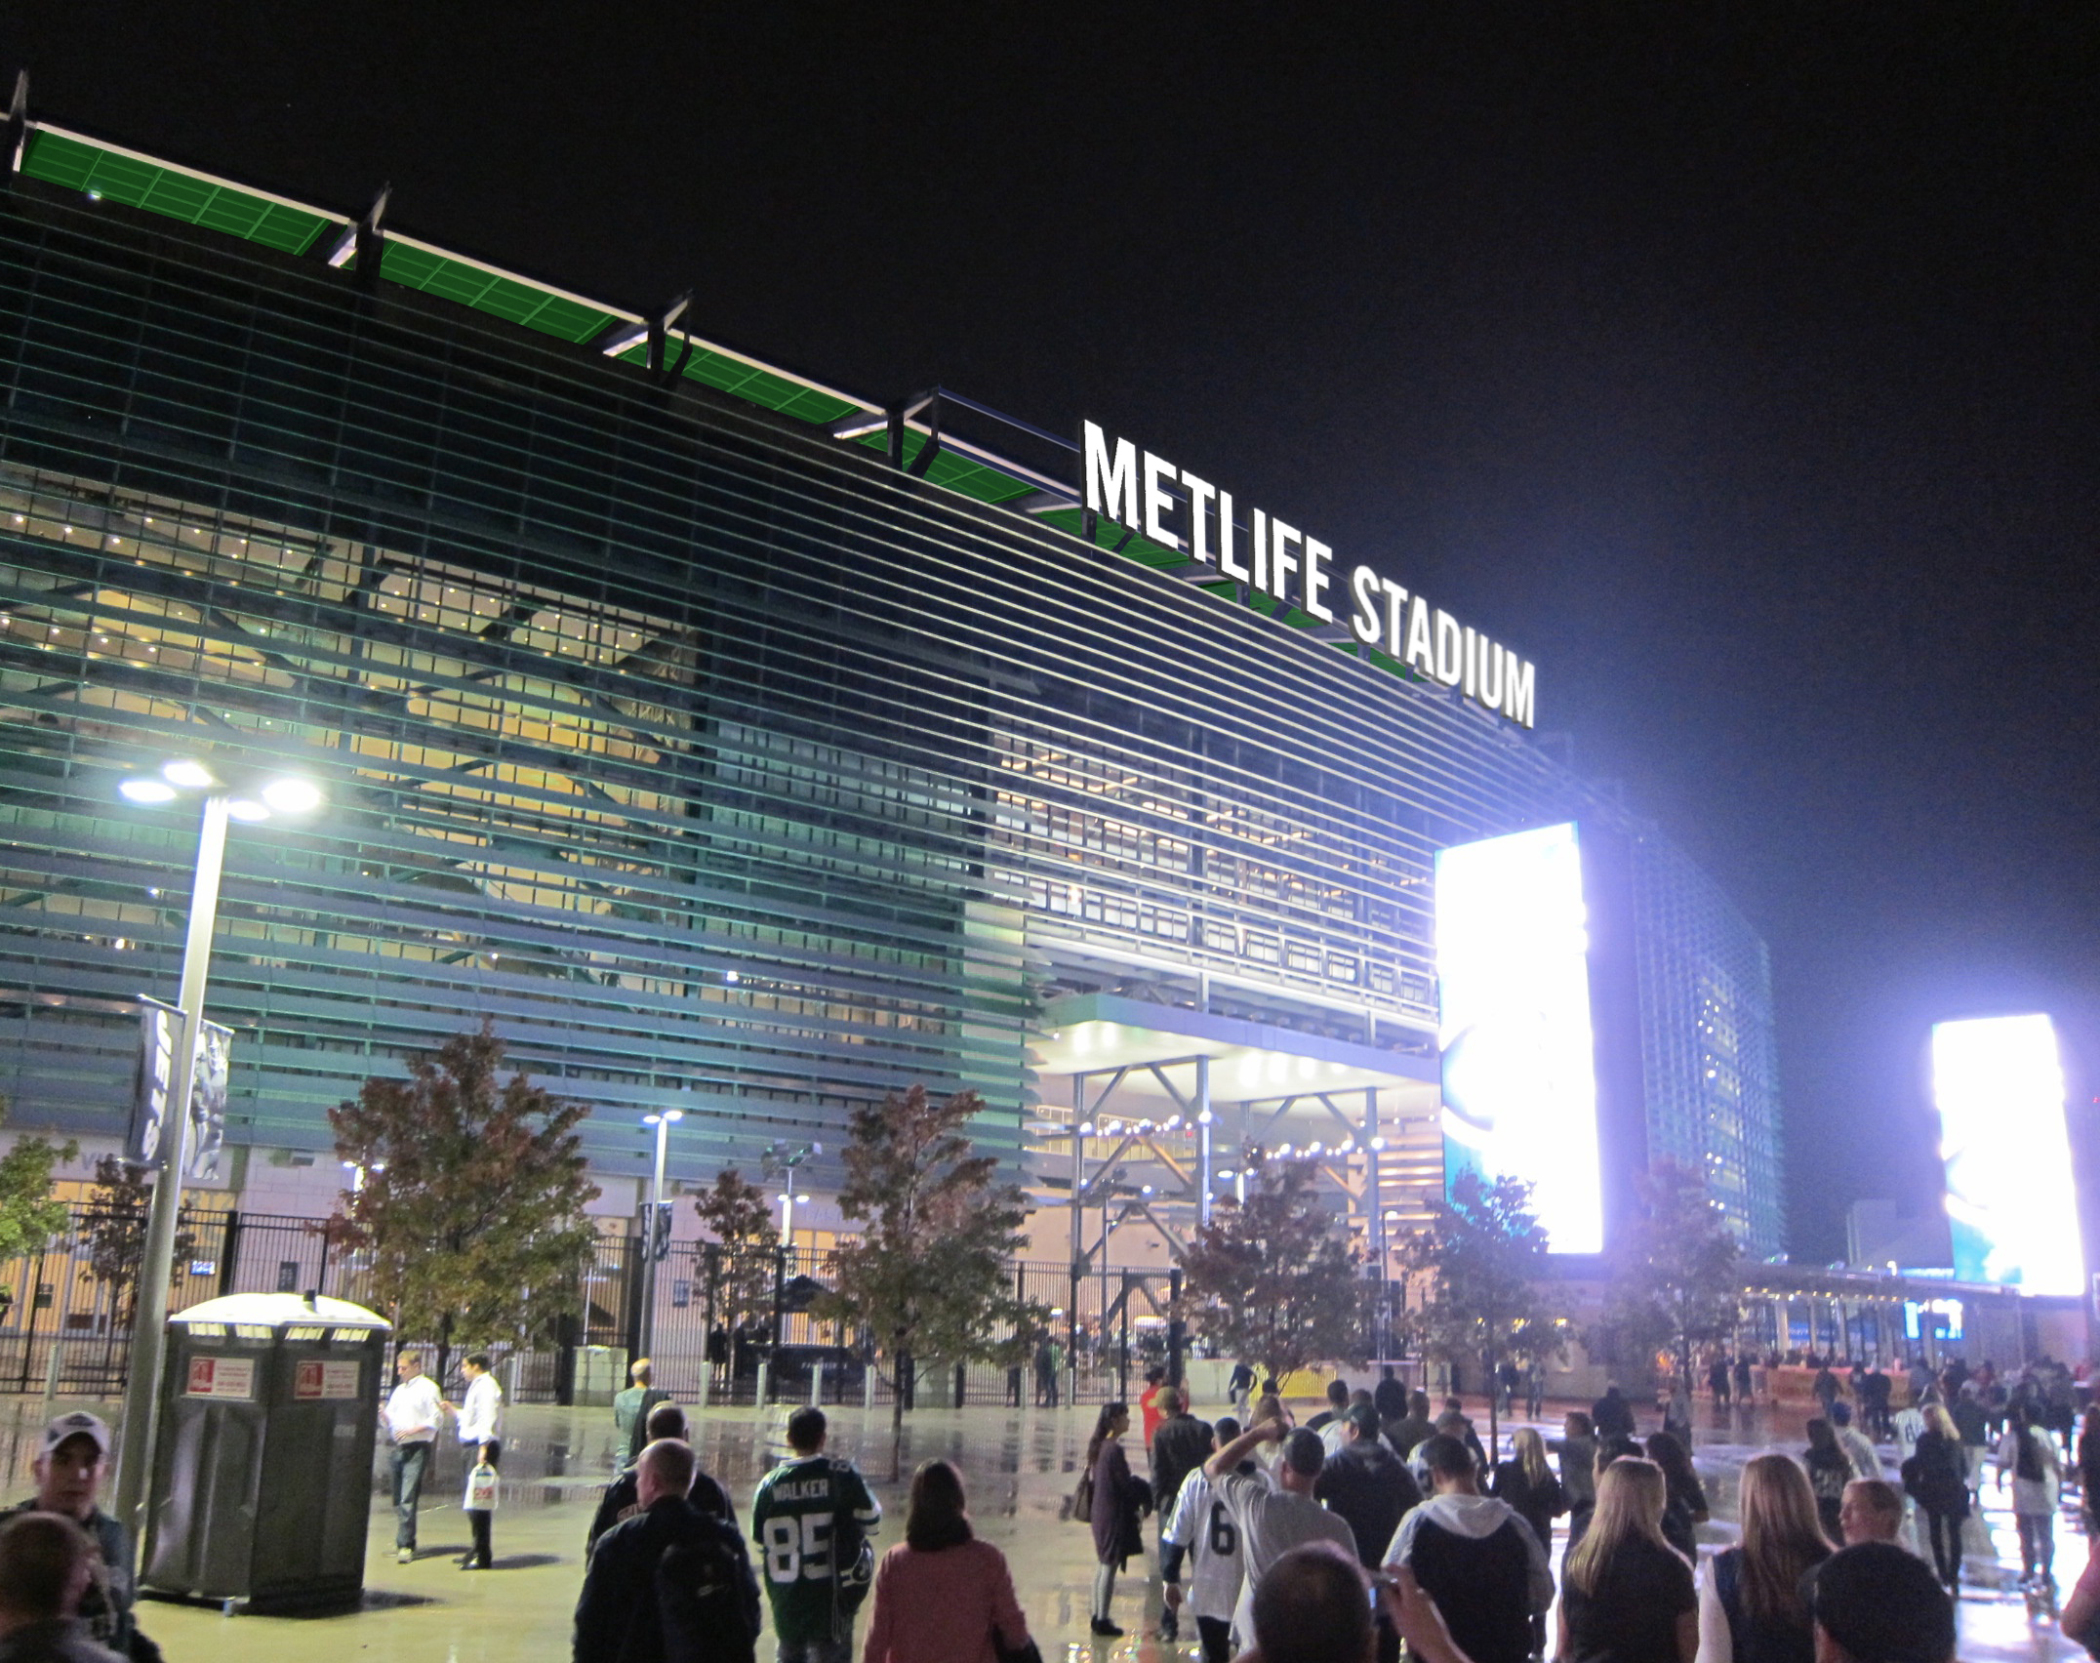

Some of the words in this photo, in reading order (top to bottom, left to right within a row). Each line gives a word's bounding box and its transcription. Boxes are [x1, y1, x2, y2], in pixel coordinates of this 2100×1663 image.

[1081, 419, 1332, 625] METLIFE
[1349, 565, 1535, 729] STADIUM
[771, 1478, 829, 1502] WALKER
[763, 1511, 834, 1583] 85
